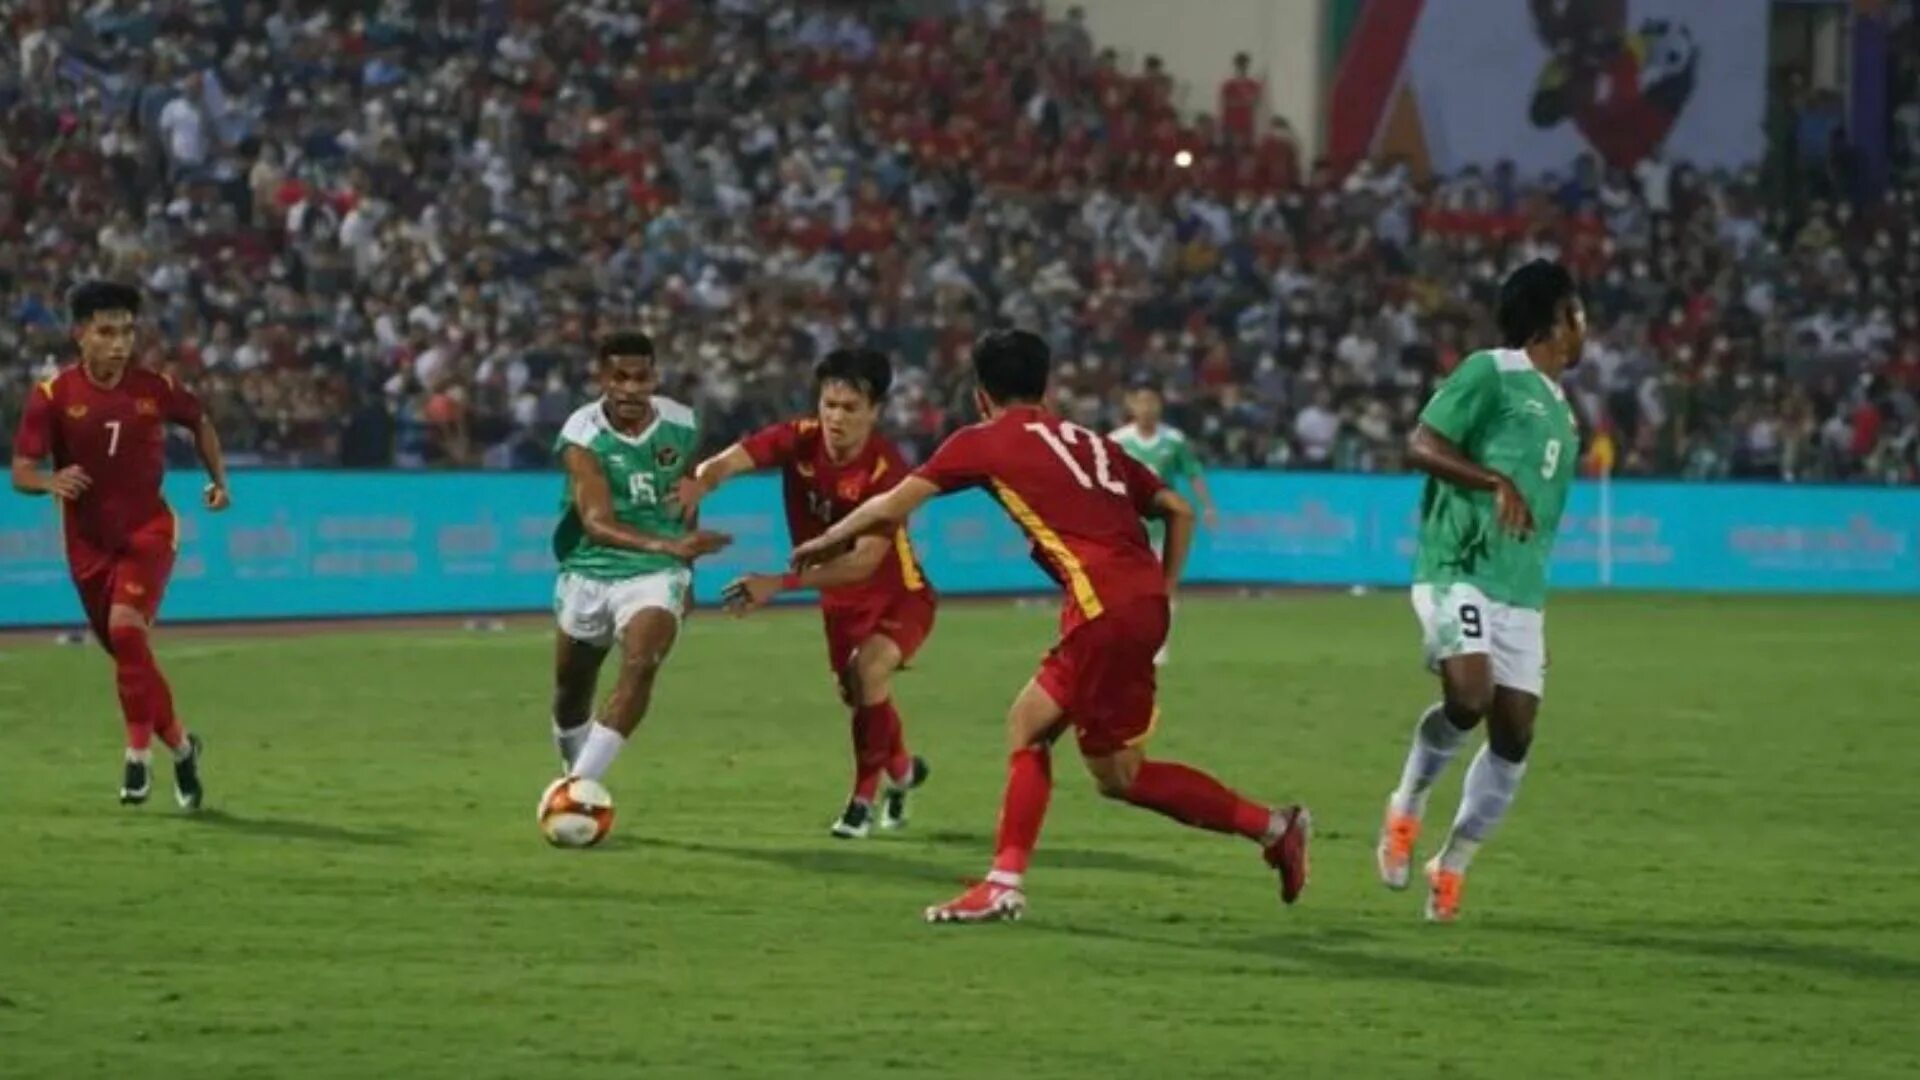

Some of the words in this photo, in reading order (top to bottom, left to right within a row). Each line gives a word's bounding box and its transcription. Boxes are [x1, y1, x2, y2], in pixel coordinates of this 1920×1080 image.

[103, 420, 121, 457] 7
[1023, 420, 1127, 496] 12
[1541, 439, 1560, 479] 9
[629, 472, 657, 505] 15
[1459, 604, 1482, 639] 9
